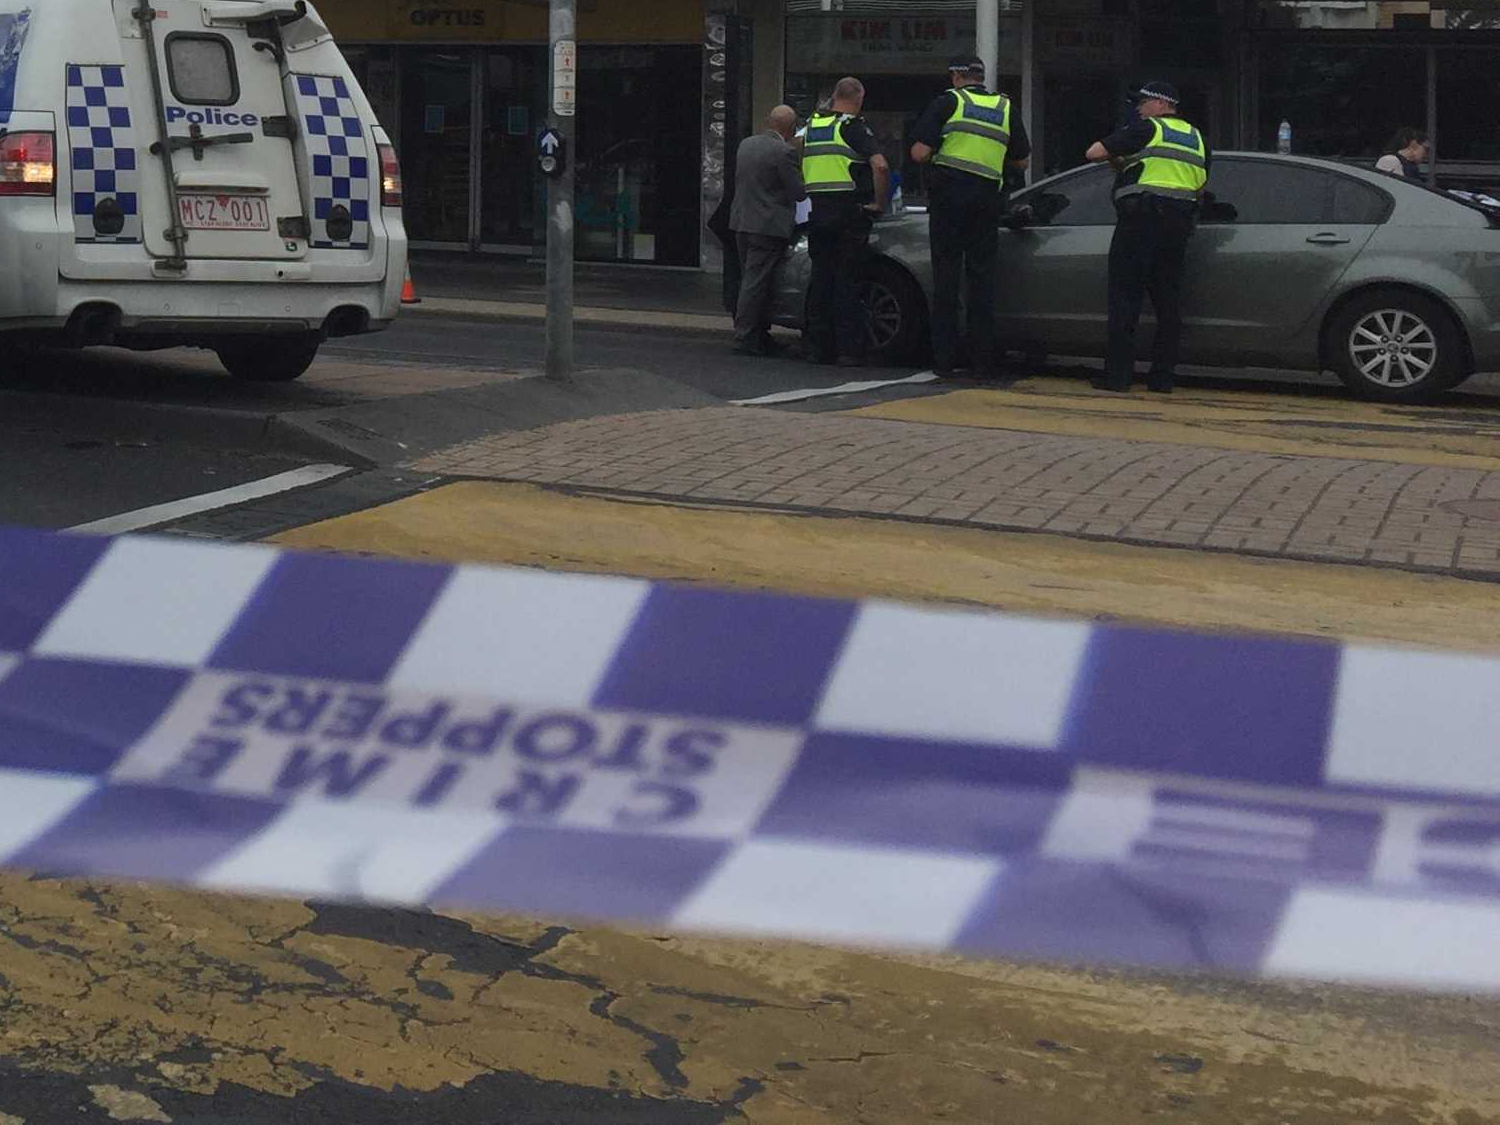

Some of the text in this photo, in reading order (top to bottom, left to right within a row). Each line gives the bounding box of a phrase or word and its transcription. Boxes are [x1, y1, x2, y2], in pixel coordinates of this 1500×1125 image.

[410, 10, 485, 27] OPTUS
[166, 106, 259, 126] Police
[231, 200, 264, 222] 001
[207, 678, 729, 777] STOPPERS
[180, 733, 706, 826] CRIME
